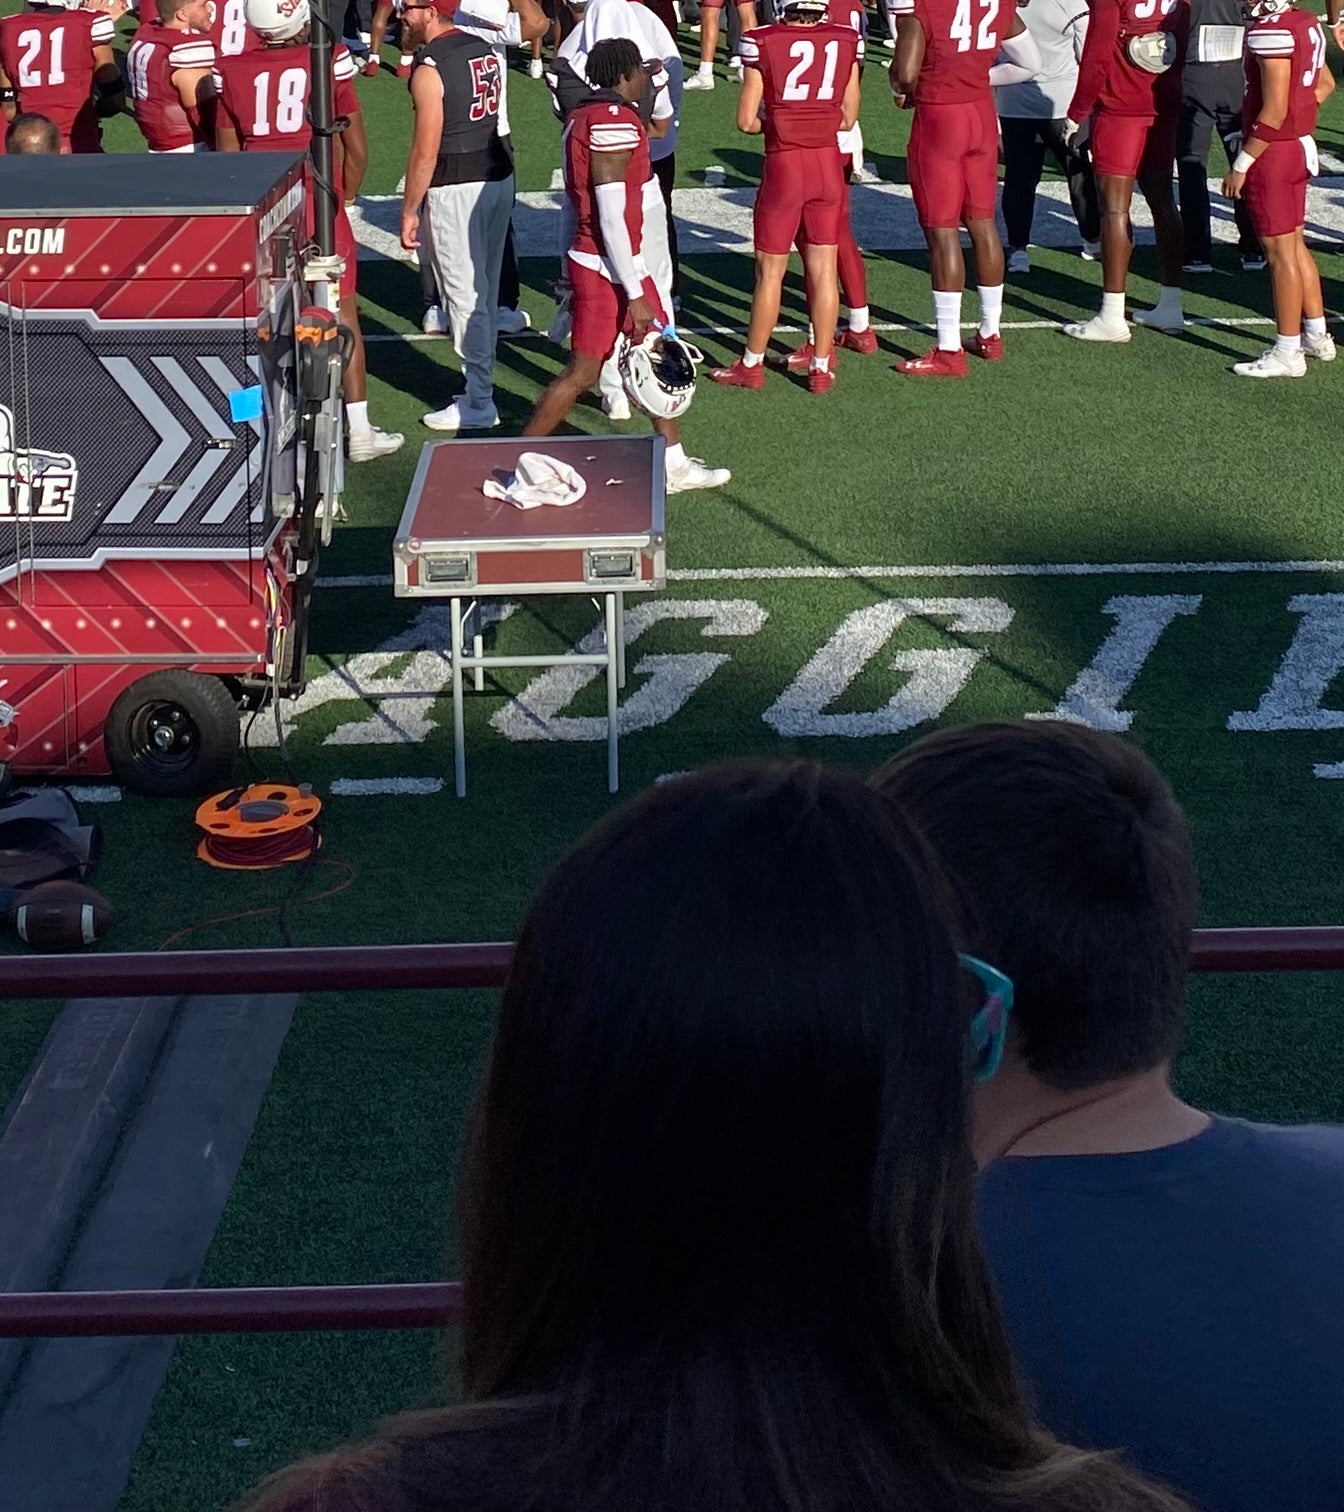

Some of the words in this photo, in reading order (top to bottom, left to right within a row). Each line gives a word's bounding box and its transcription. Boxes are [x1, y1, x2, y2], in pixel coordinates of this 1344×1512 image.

[16, 26, 66, 88] 21
[467, 53, 503, 123] 53
[782, 39, 840, 101] 21
[252, 67, 308, 137] 18
